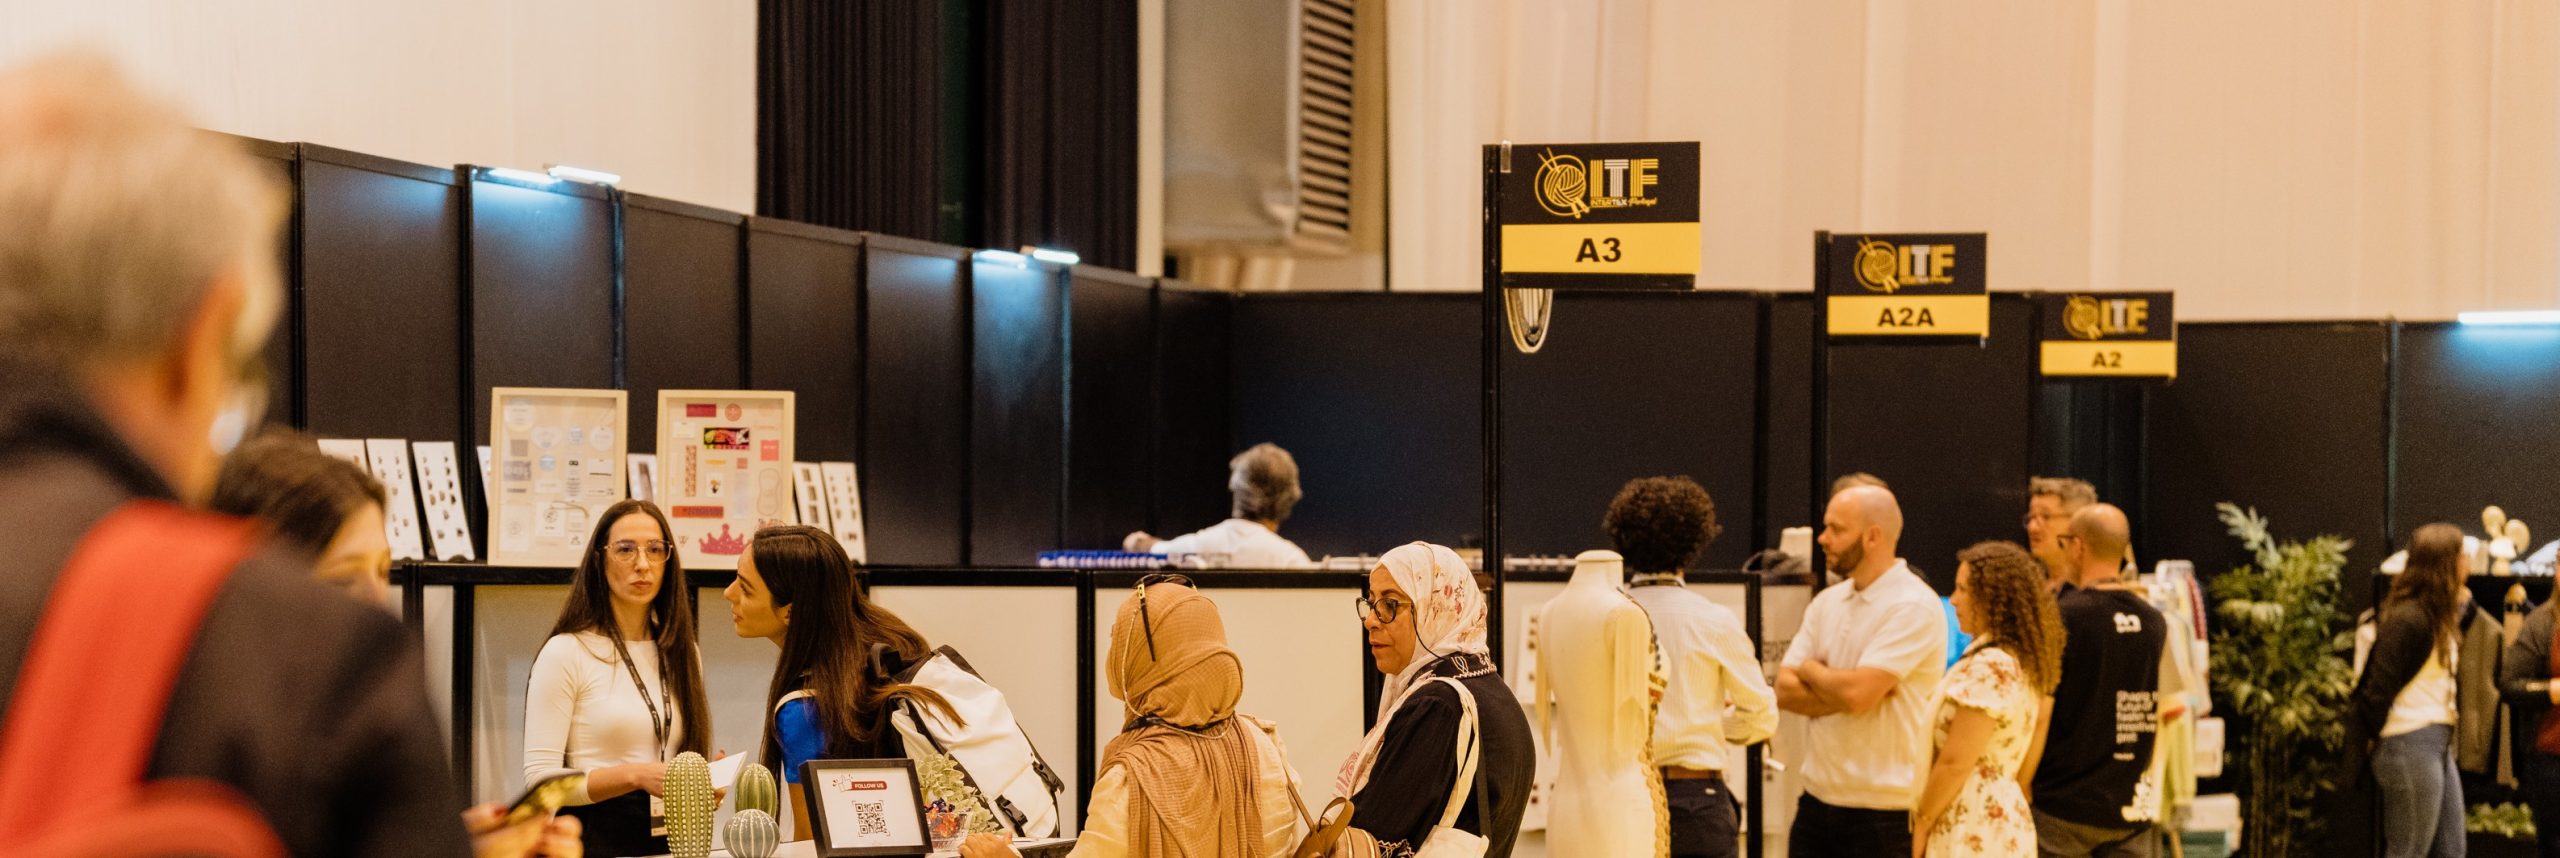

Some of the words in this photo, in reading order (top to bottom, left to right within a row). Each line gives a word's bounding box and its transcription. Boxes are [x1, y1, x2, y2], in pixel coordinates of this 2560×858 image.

[1576, 237, 1622, 263] A3
[1877, 307, 1935, 327] A2A
[2091, 351, 2122, 369] A2
